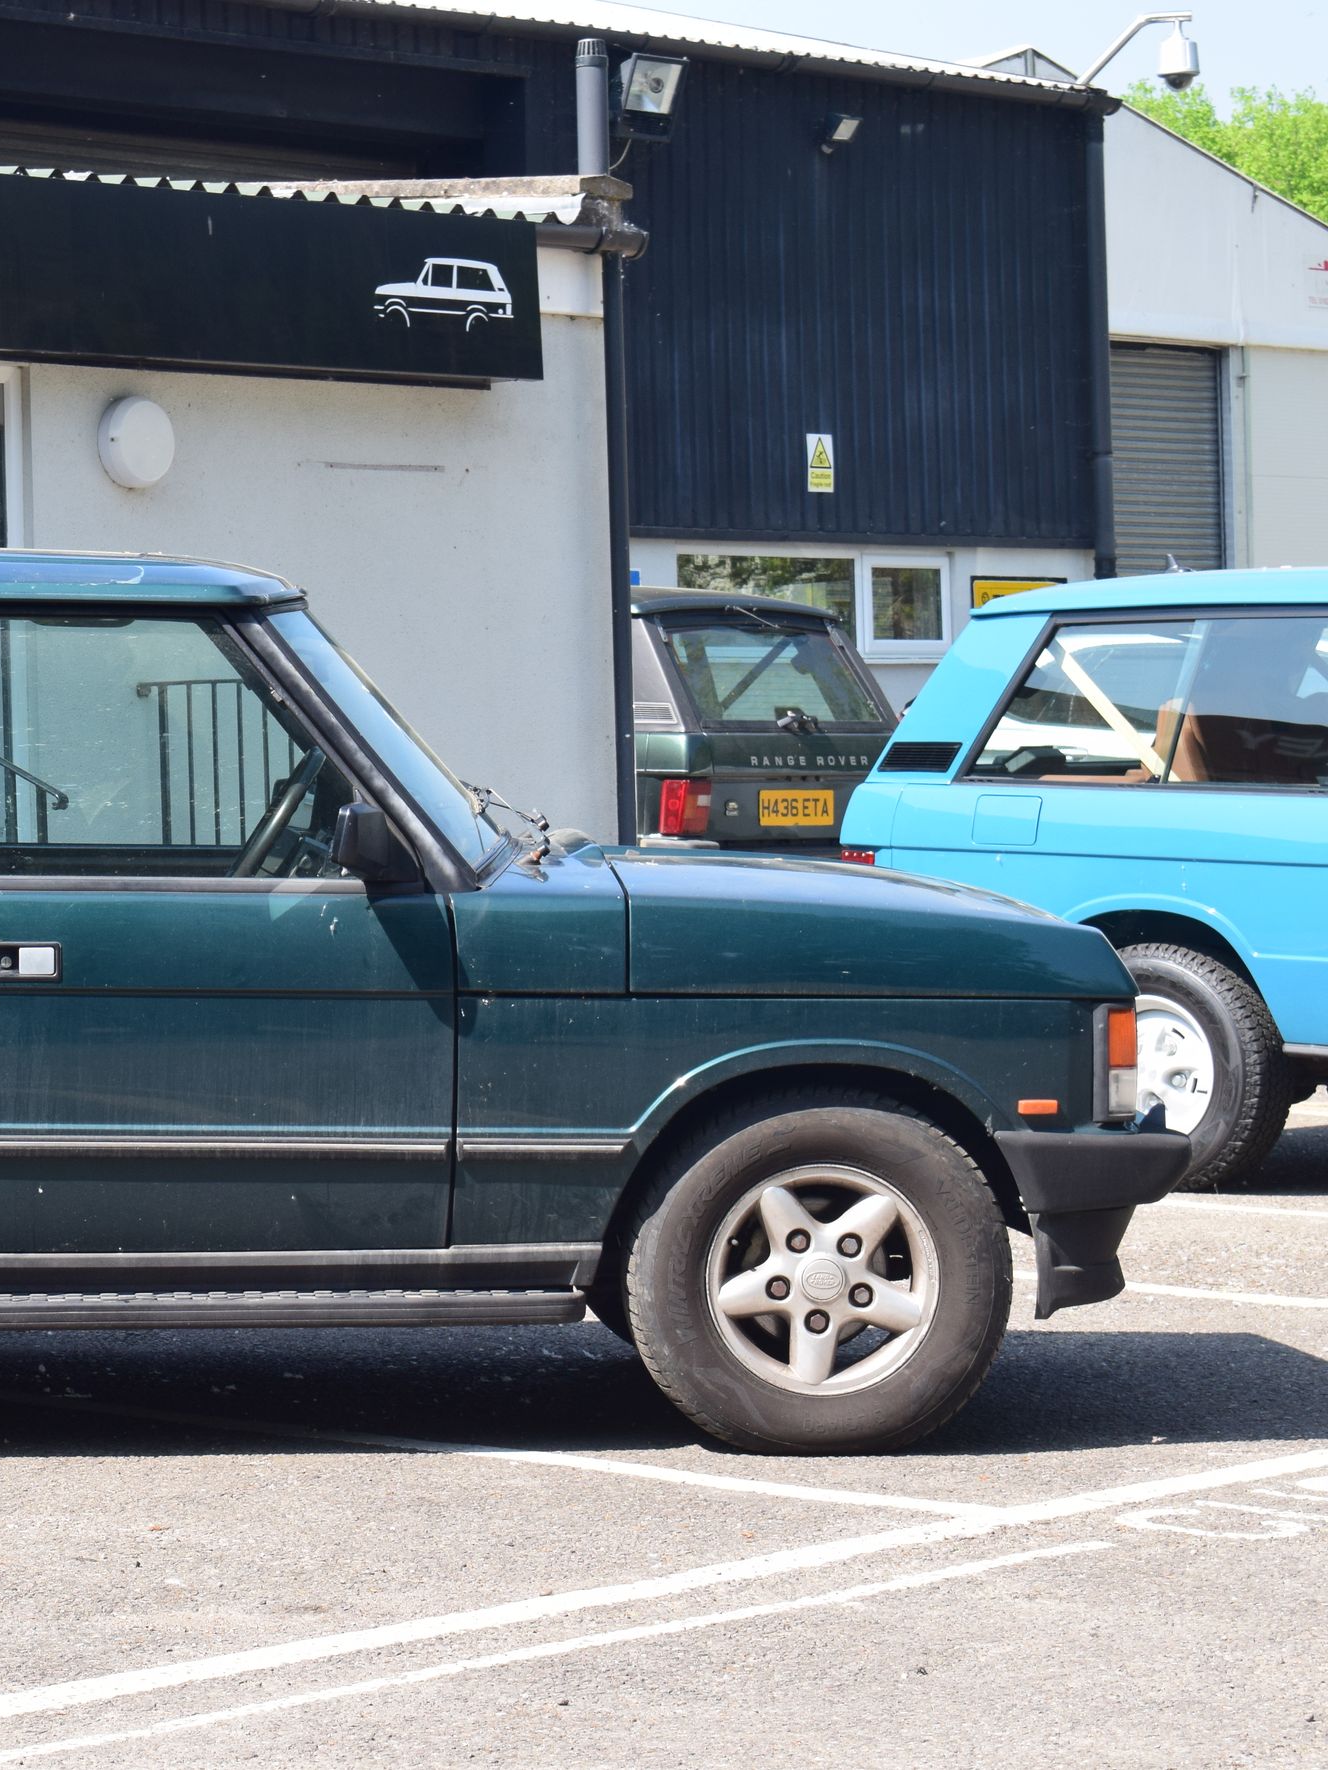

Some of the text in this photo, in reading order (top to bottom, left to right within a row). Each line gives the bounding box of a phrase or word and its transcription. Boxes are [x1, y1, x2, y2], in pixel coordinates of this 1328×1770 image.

[750, 755, 869, 767] RANGE ROVER
[761, 798, 830, 818] H436 ETA
